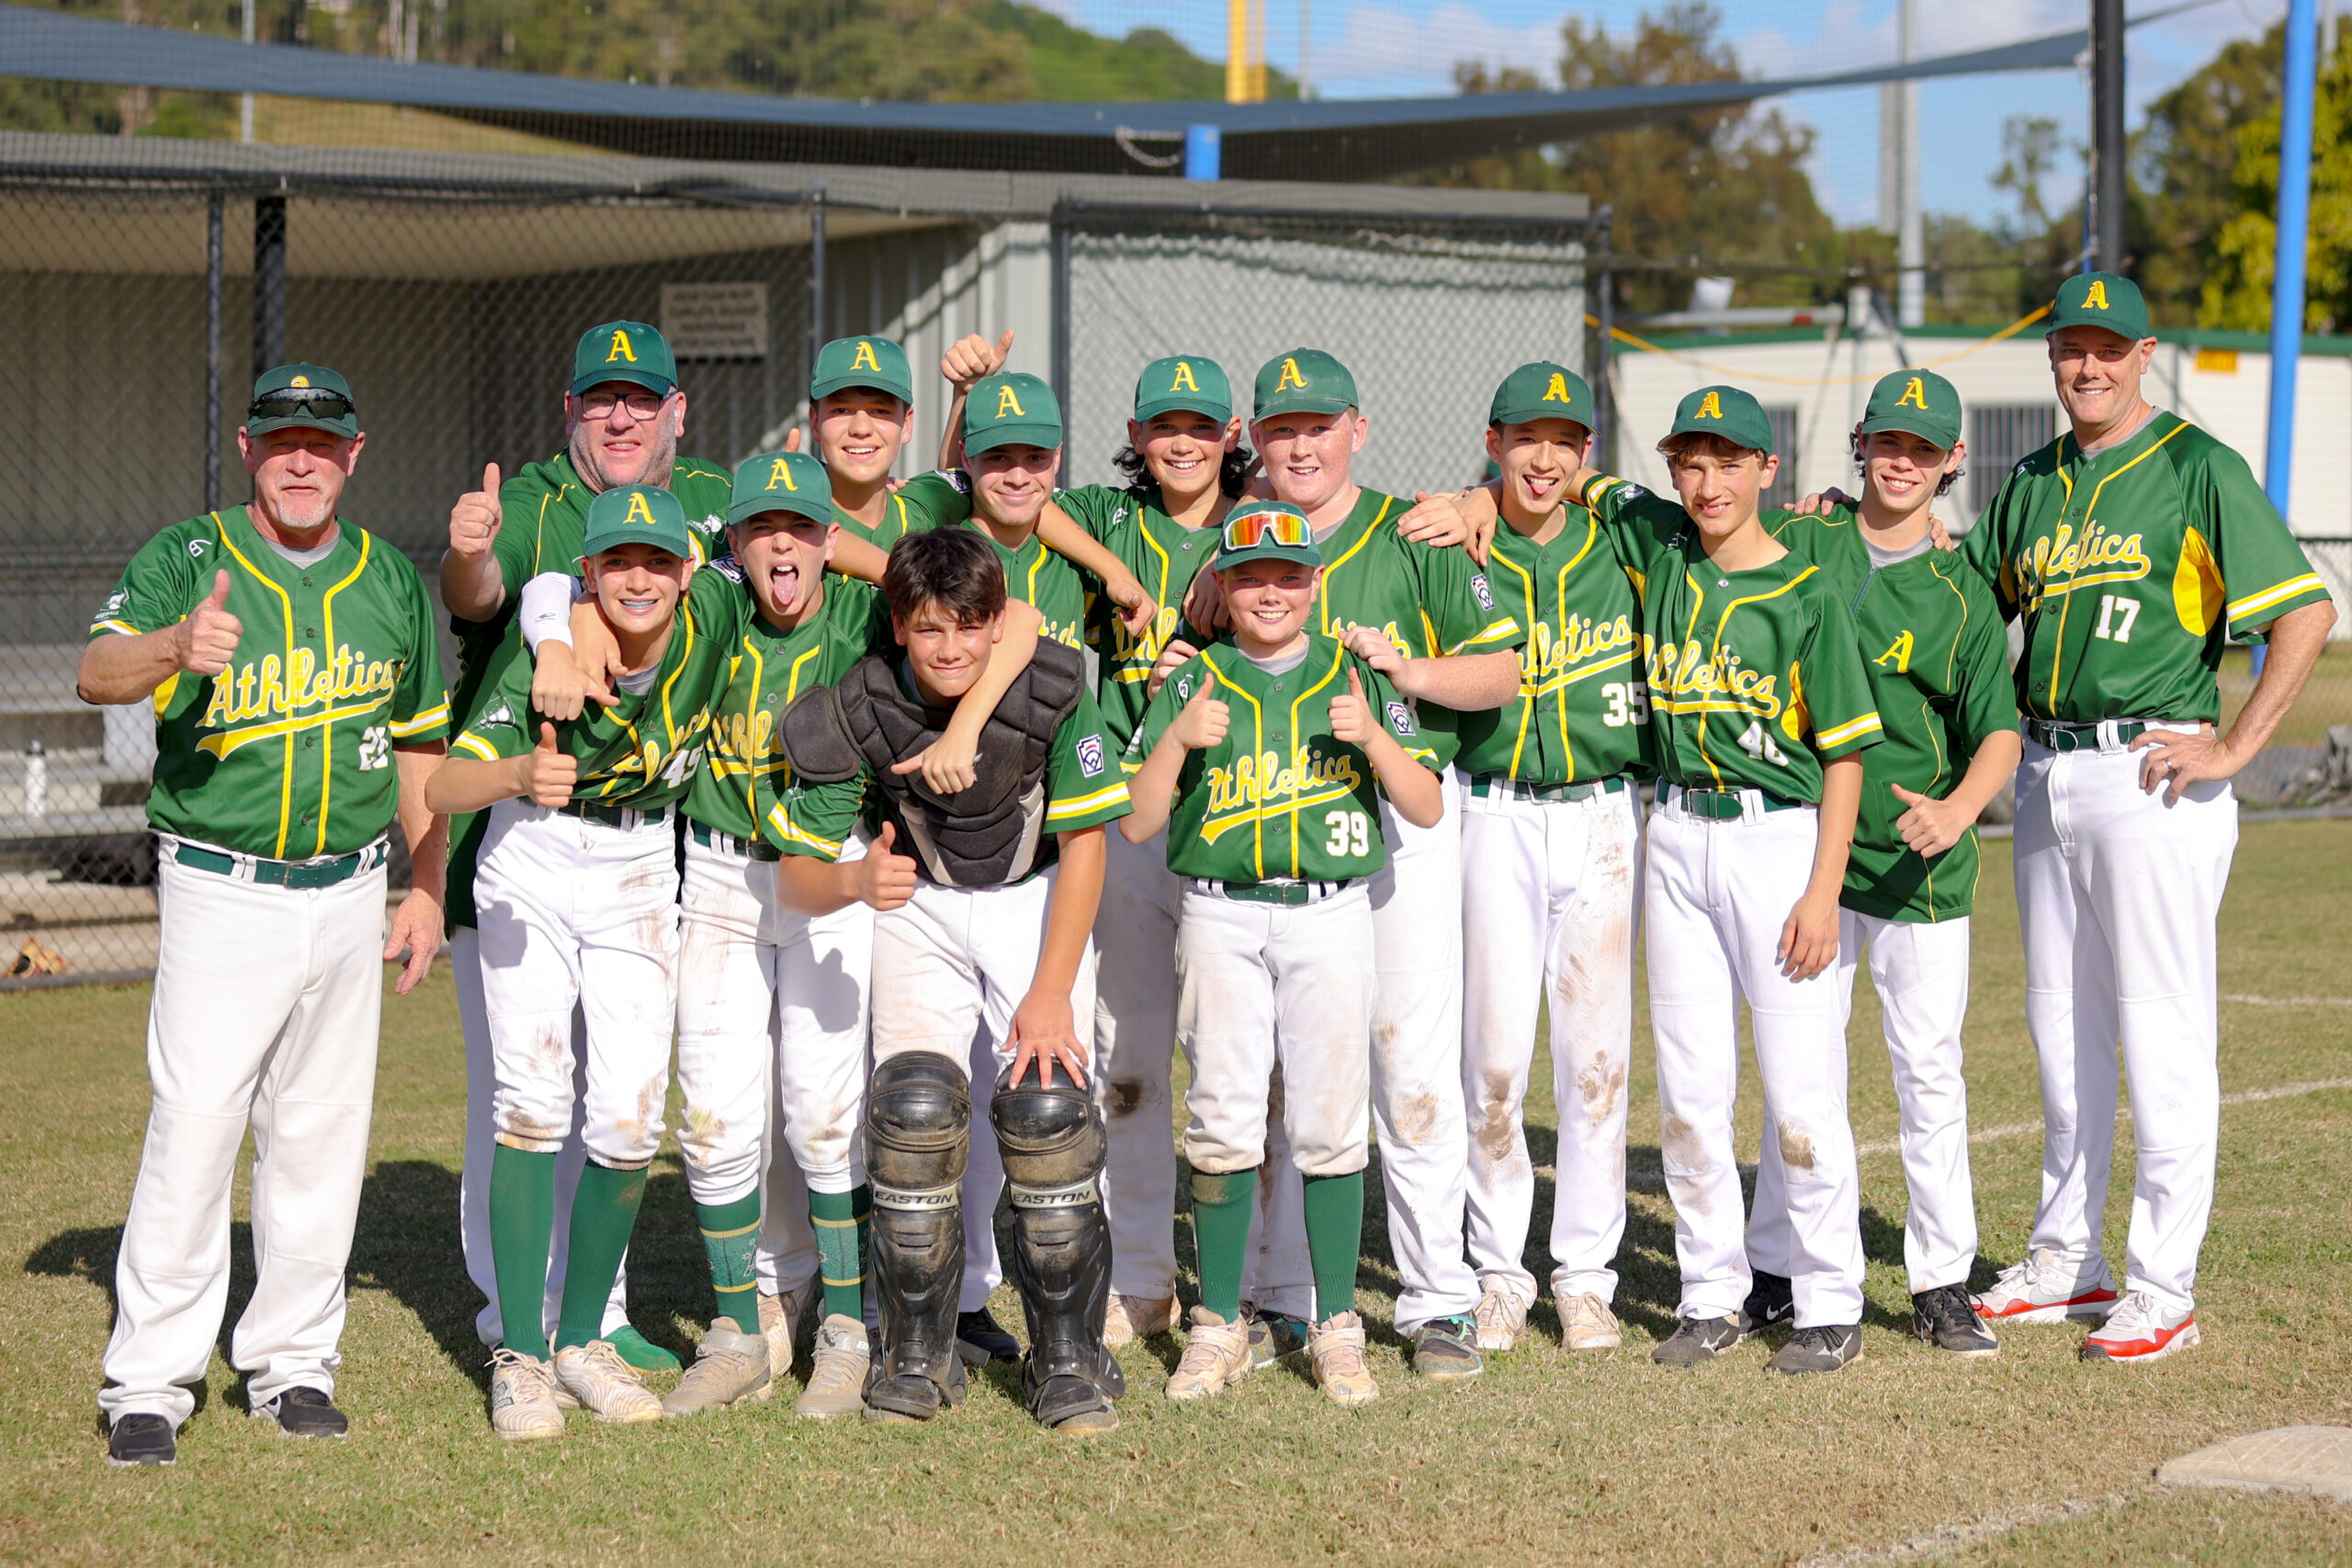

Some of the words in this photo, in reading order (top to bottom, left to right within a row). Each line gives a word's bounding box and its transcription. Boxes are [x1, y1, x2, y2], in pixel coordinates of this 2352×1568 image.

[2081, 280, 2110, 310] A
[605, 329, 638, 363] A
[850, 341, 882, 371] A
[1170, 361, 1199, 392] A
[1274, 358, 1307, 393] A
[1542, 372, 1572, 403] A
[995, 385, 1026, 419] A
[1693, 390, 1724, 419] A
[1894, 377, 1928, 410] A
[764, 458, 797, 491] A
[623, 492, 656, 525] A
[2095, 594, 2141, 643] 17
[1873, 629, 1915, 673] A
[195, 643, 394, 728] Athletics
[1601, 682, 1649, 728] 35
[1325, 810, 1369, 857] 39
[875, 1190, 953, 1204] EASTON
[1012, 1190, 1091, 1204] EASTON
